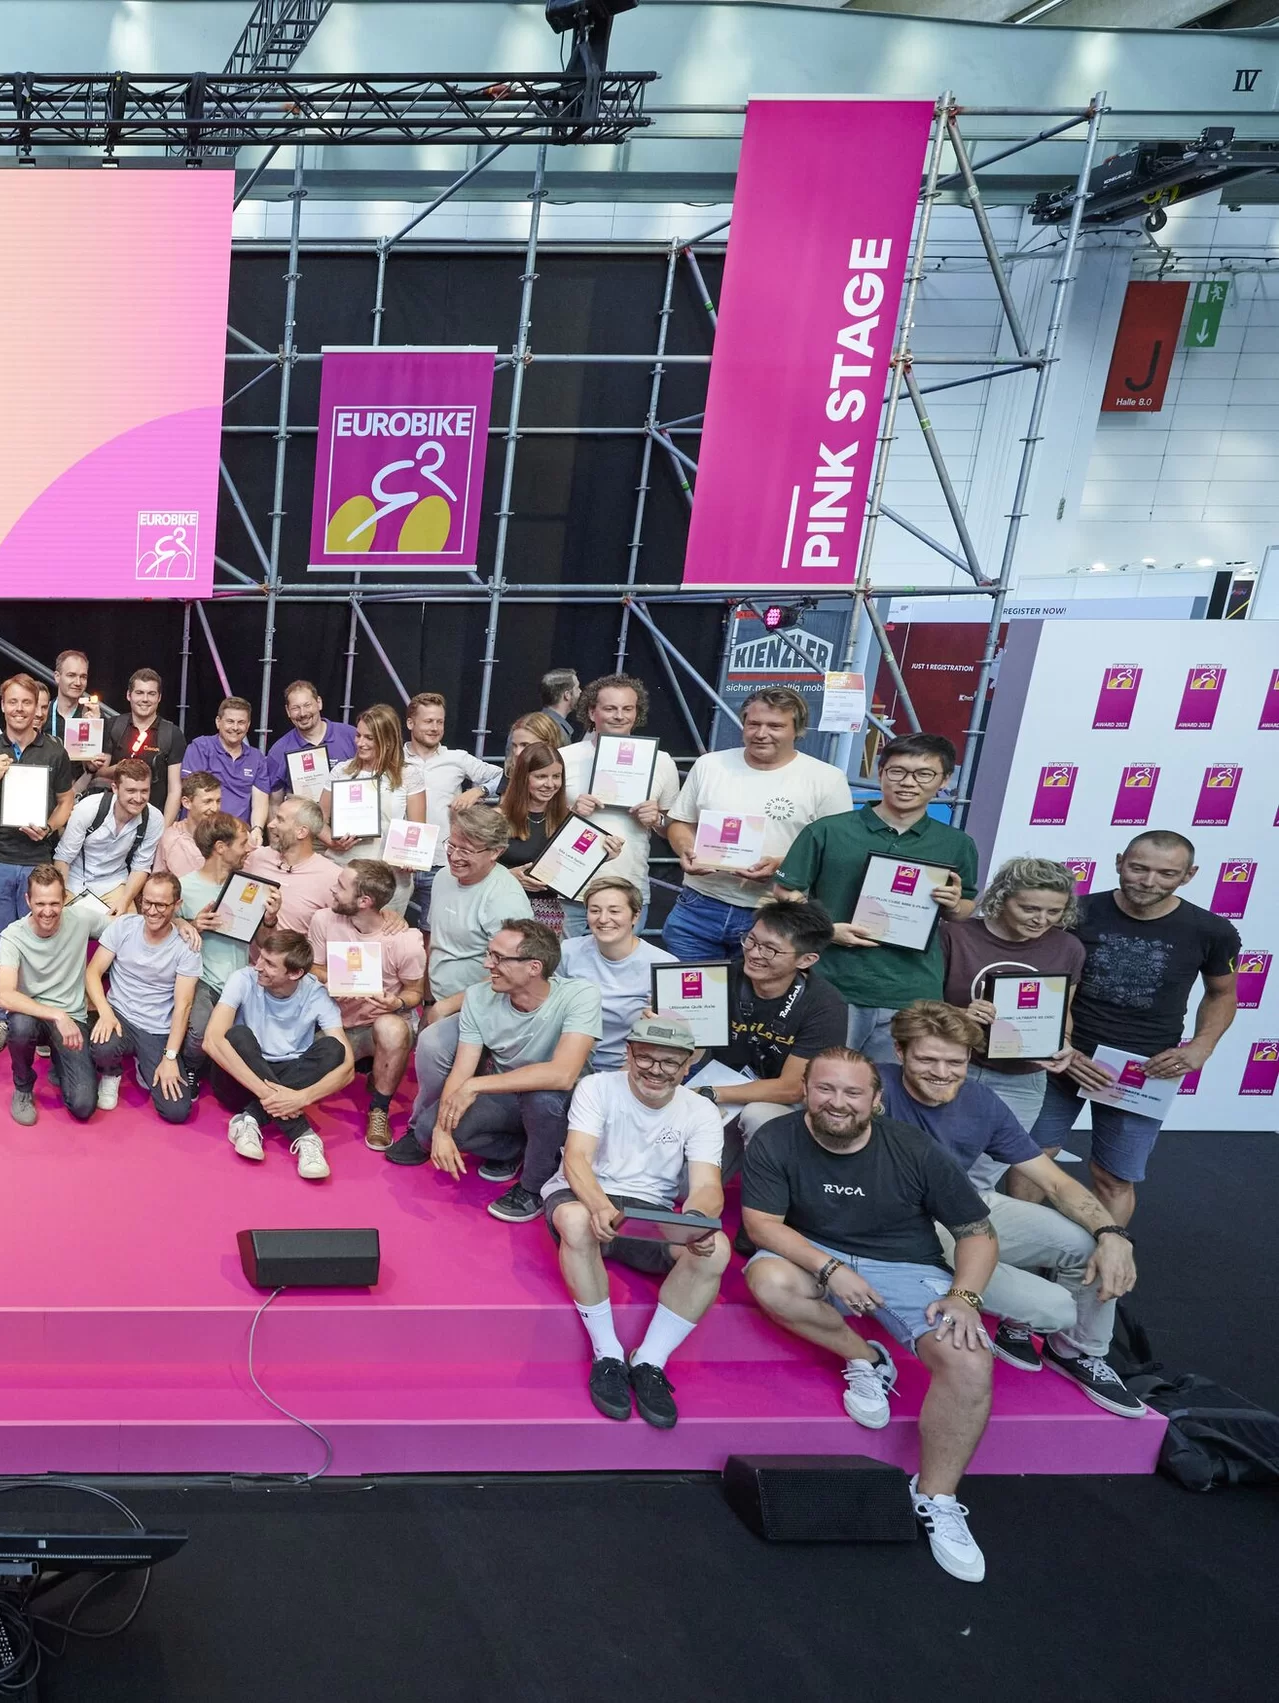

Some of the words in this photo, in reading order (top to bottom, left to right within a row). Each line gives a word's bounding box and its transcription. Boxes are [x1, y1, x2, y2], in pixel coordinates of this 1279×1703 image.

[1232, 69, 1262, 92] IV
[825, 238, 892, 422] STAGE
[1124, 340, 1162, 392] J
[1115, 398, 1136, 406] Halle
[1138, 398, 1152, 406] 8.0
[336, 411, 472, 437] EUROBIKE
[801, 440, 859, 567] PINK
[140, 513, 197, 526] EUROBIKE
[1003, 607, 1040, 615] REGISTER
[1042, 607, 1067, 615] NOW!
[733, 632, 830, 669] KIENZLER
[911, 662, 925, 670] JUST
[930, 663, 974, 673] REGISTRATION
[823, 1183, 866, 1197] RVCA
